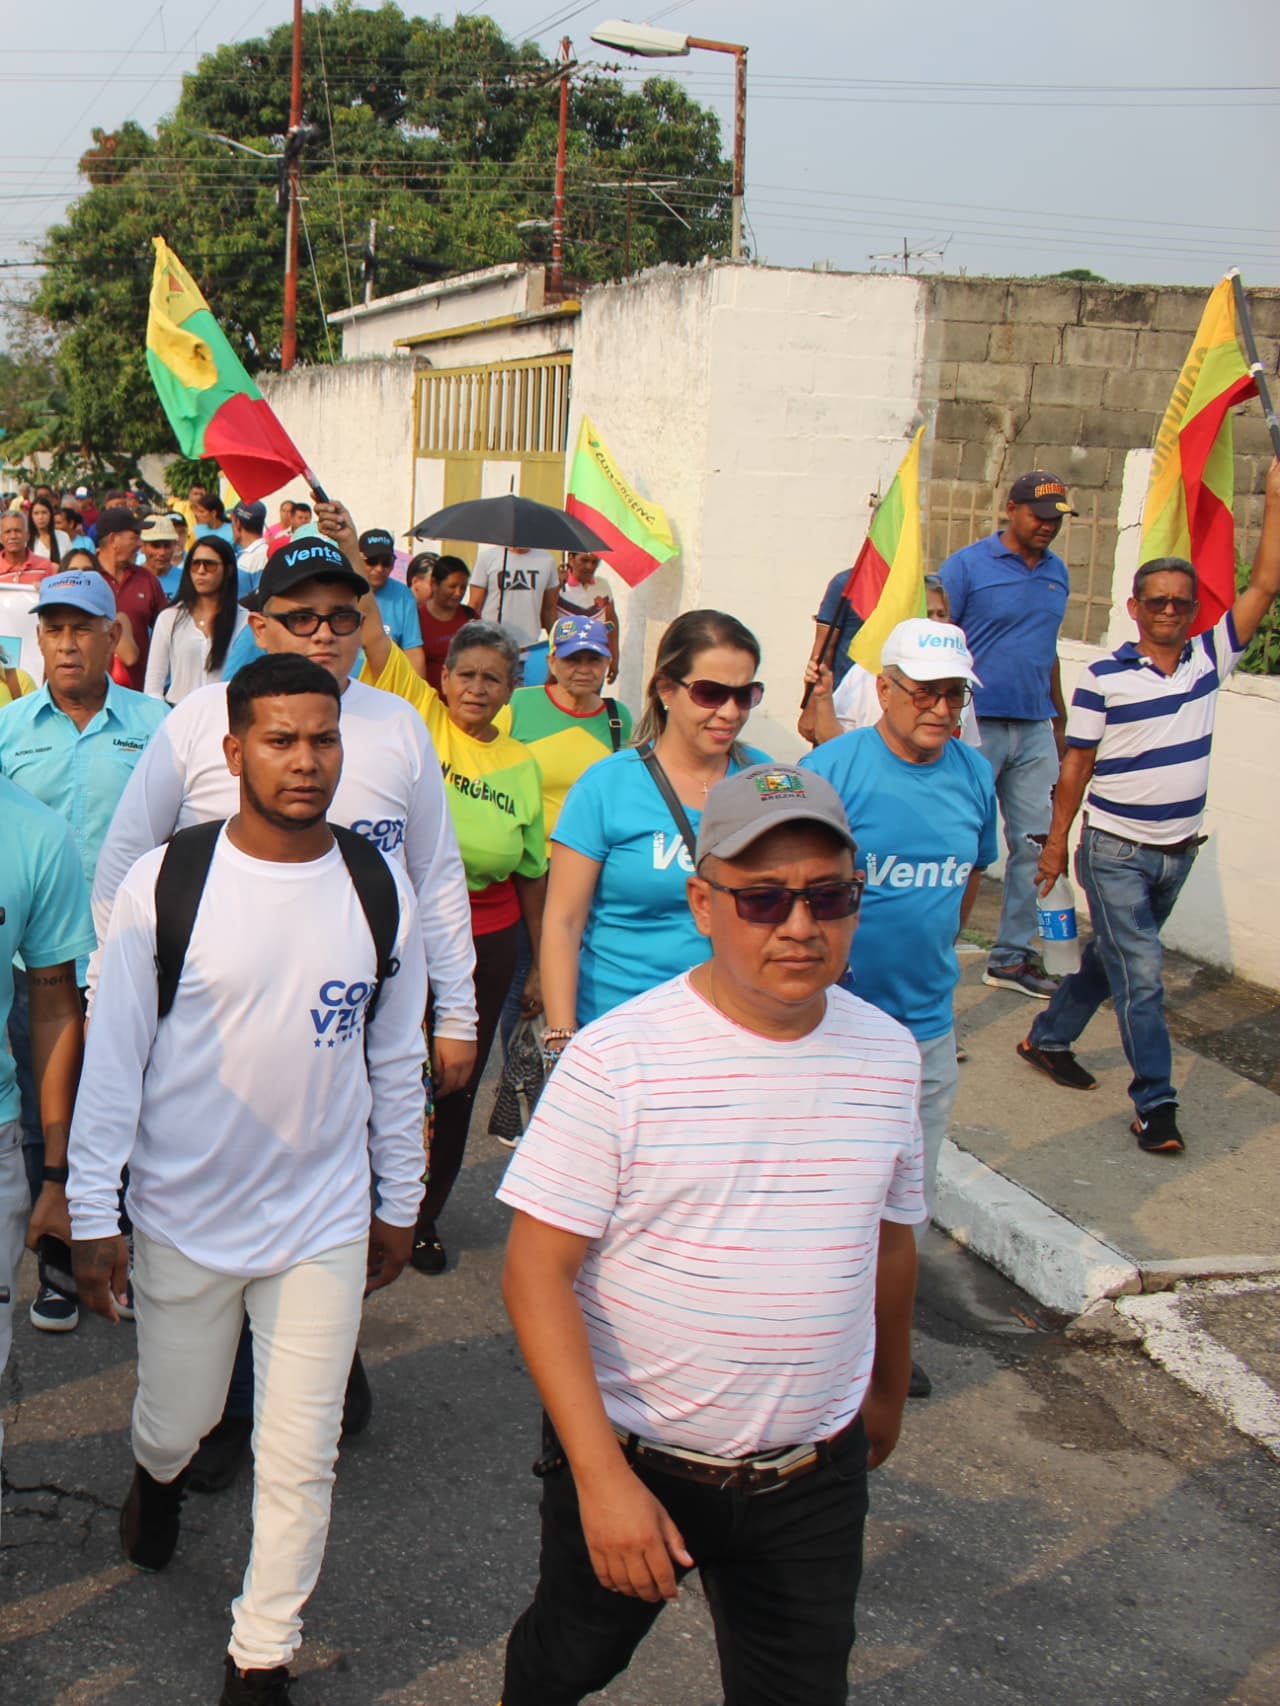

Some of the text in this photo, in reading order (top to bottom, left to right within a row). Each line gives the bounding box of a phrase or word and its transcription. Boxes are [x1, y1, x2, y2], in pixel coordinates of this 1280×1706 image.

[285, 545, 343, 567] Vente
[498, 569, 540, 591] CAT
[439, 760, 516, 818] VERGENCIA
[865, 853, 973, 888] Vente
[319, 980, 376, 1007] CO
